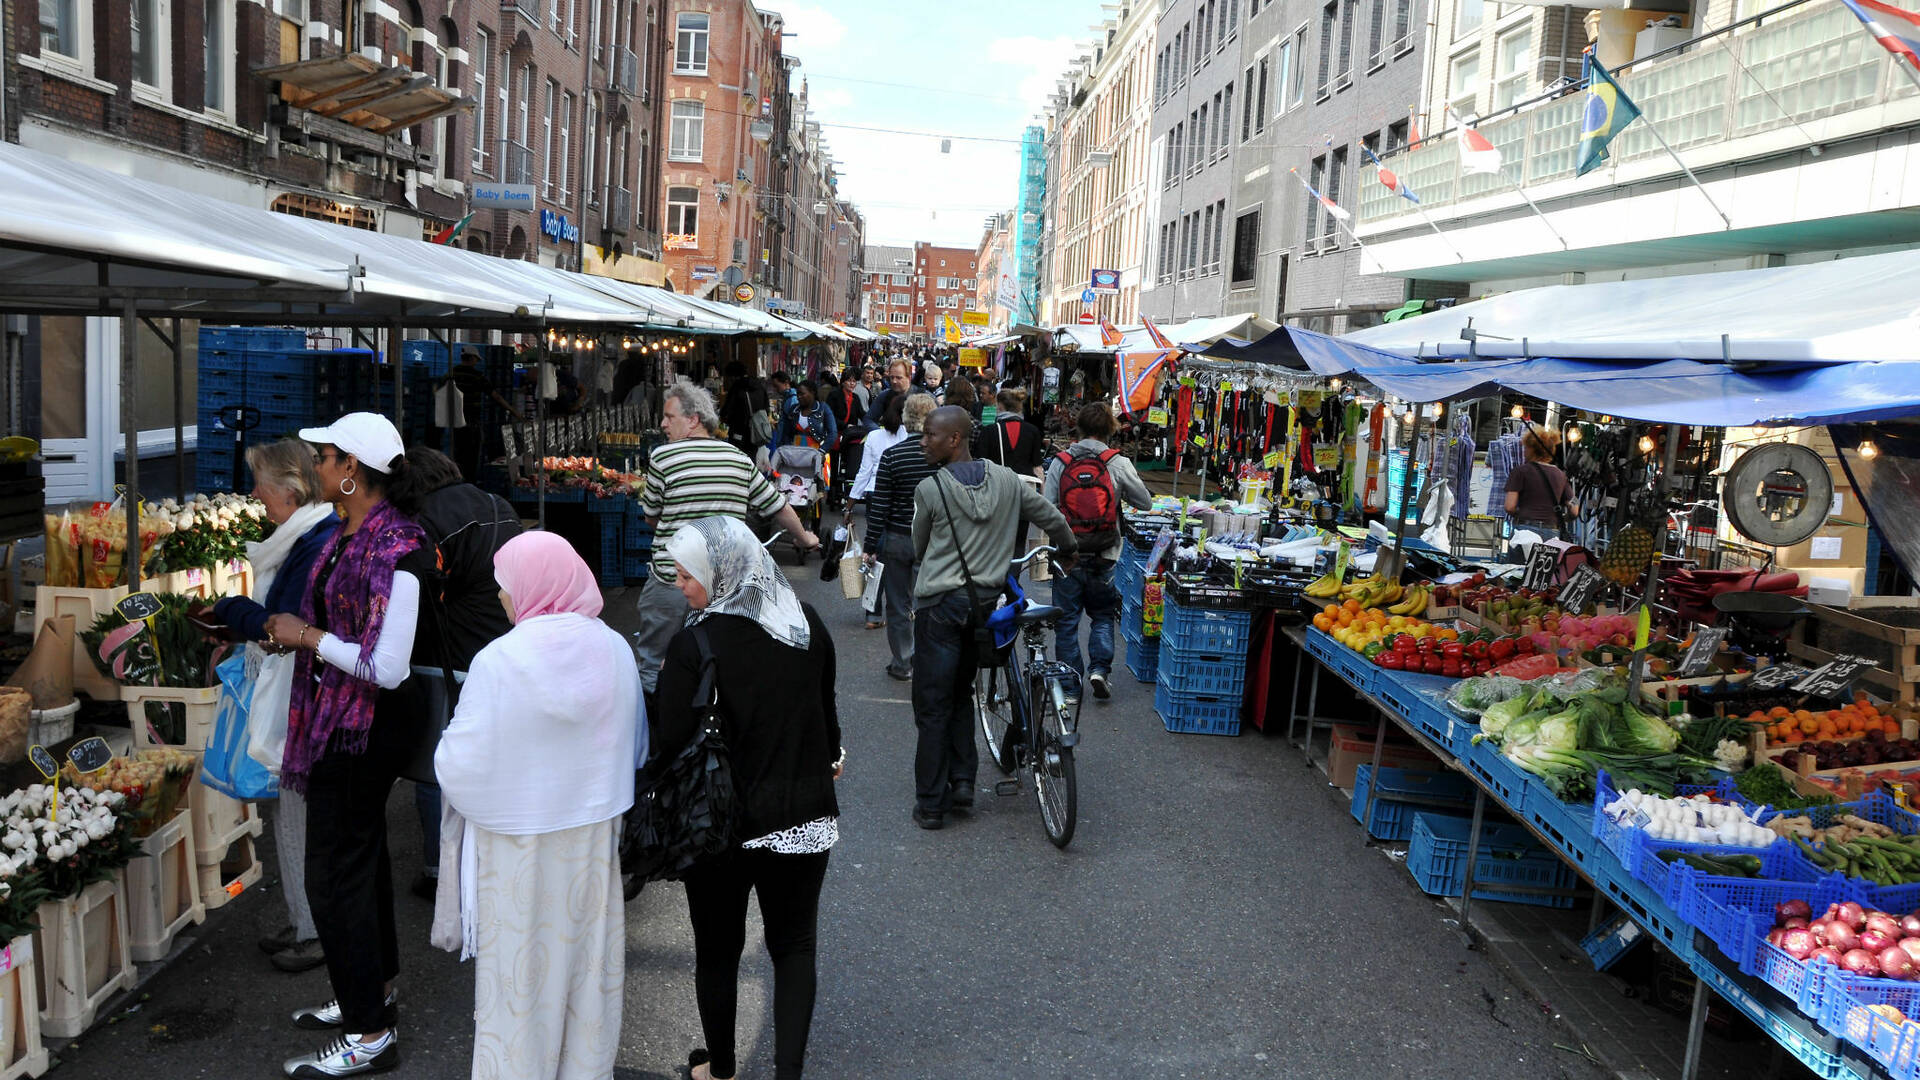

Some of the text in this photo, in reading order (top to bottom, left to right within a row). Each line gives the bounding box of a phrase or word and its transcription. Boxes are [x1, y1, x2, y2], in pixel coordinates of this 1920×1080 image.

[476, 188, 530, 201] Baby Boem
[542, 209, 579, 244] Baby Boem
